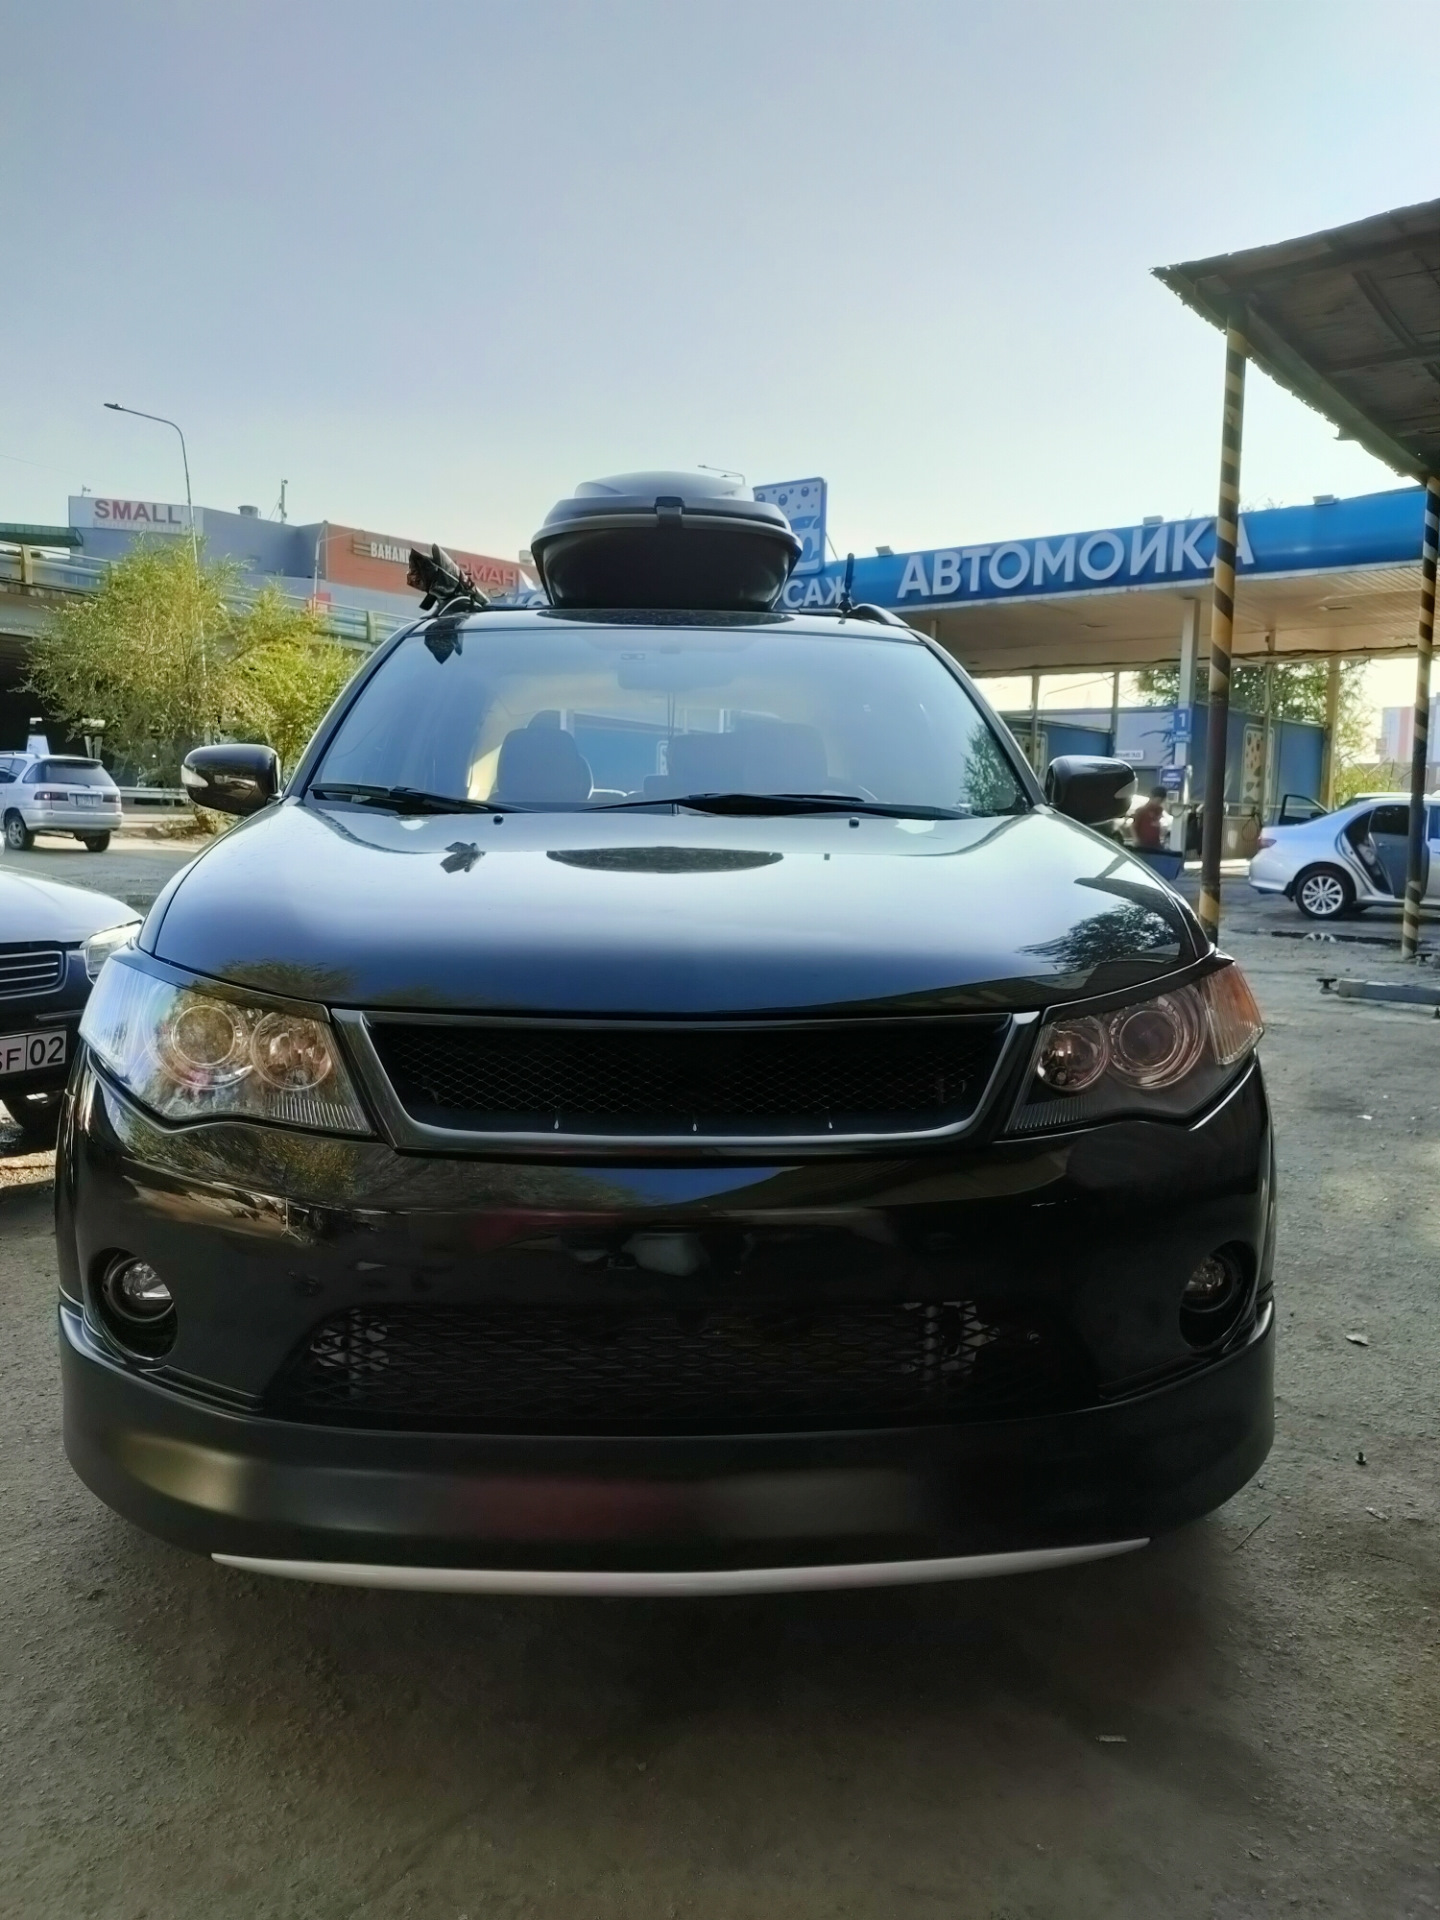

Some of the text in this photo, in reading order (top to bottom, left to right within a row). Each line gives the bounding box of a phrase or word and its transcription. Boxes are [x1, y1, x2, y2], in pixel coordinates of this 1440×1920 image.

[94, 499, 182, 525] SMALL
[1178, 712, 1187, 728] 1
[0, 1036, 64, 1071] F 02
